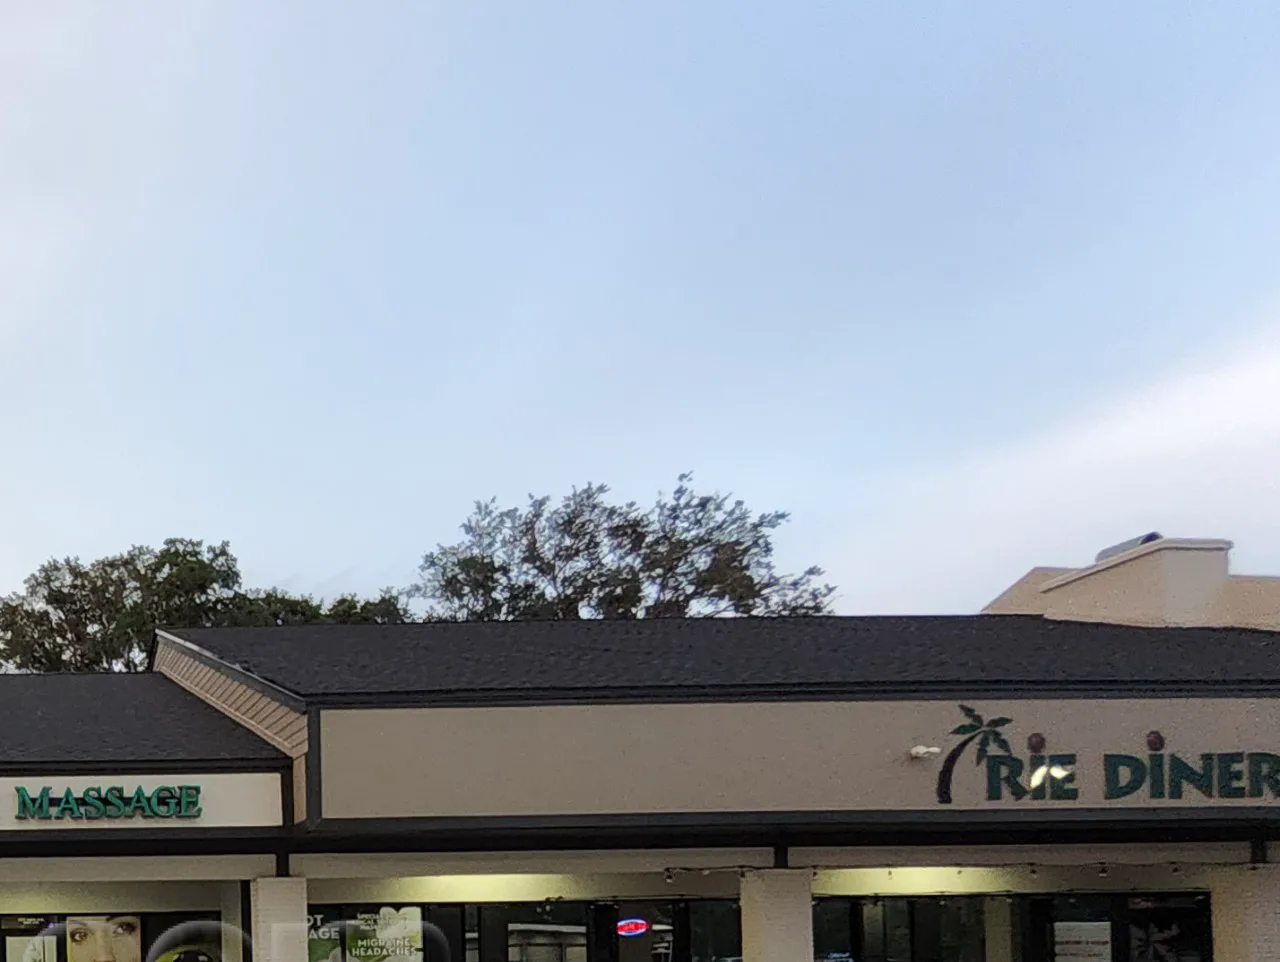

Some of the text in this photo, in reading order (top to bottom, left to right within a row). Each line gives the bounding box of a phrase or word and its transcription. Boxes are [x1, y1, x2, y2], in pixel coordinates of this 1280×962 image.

[14, 785, 203, 820] MASSAGE
[357, 938, 410, 948] MIGRAINE
[351, 947, 417, 957] HEADACHES
